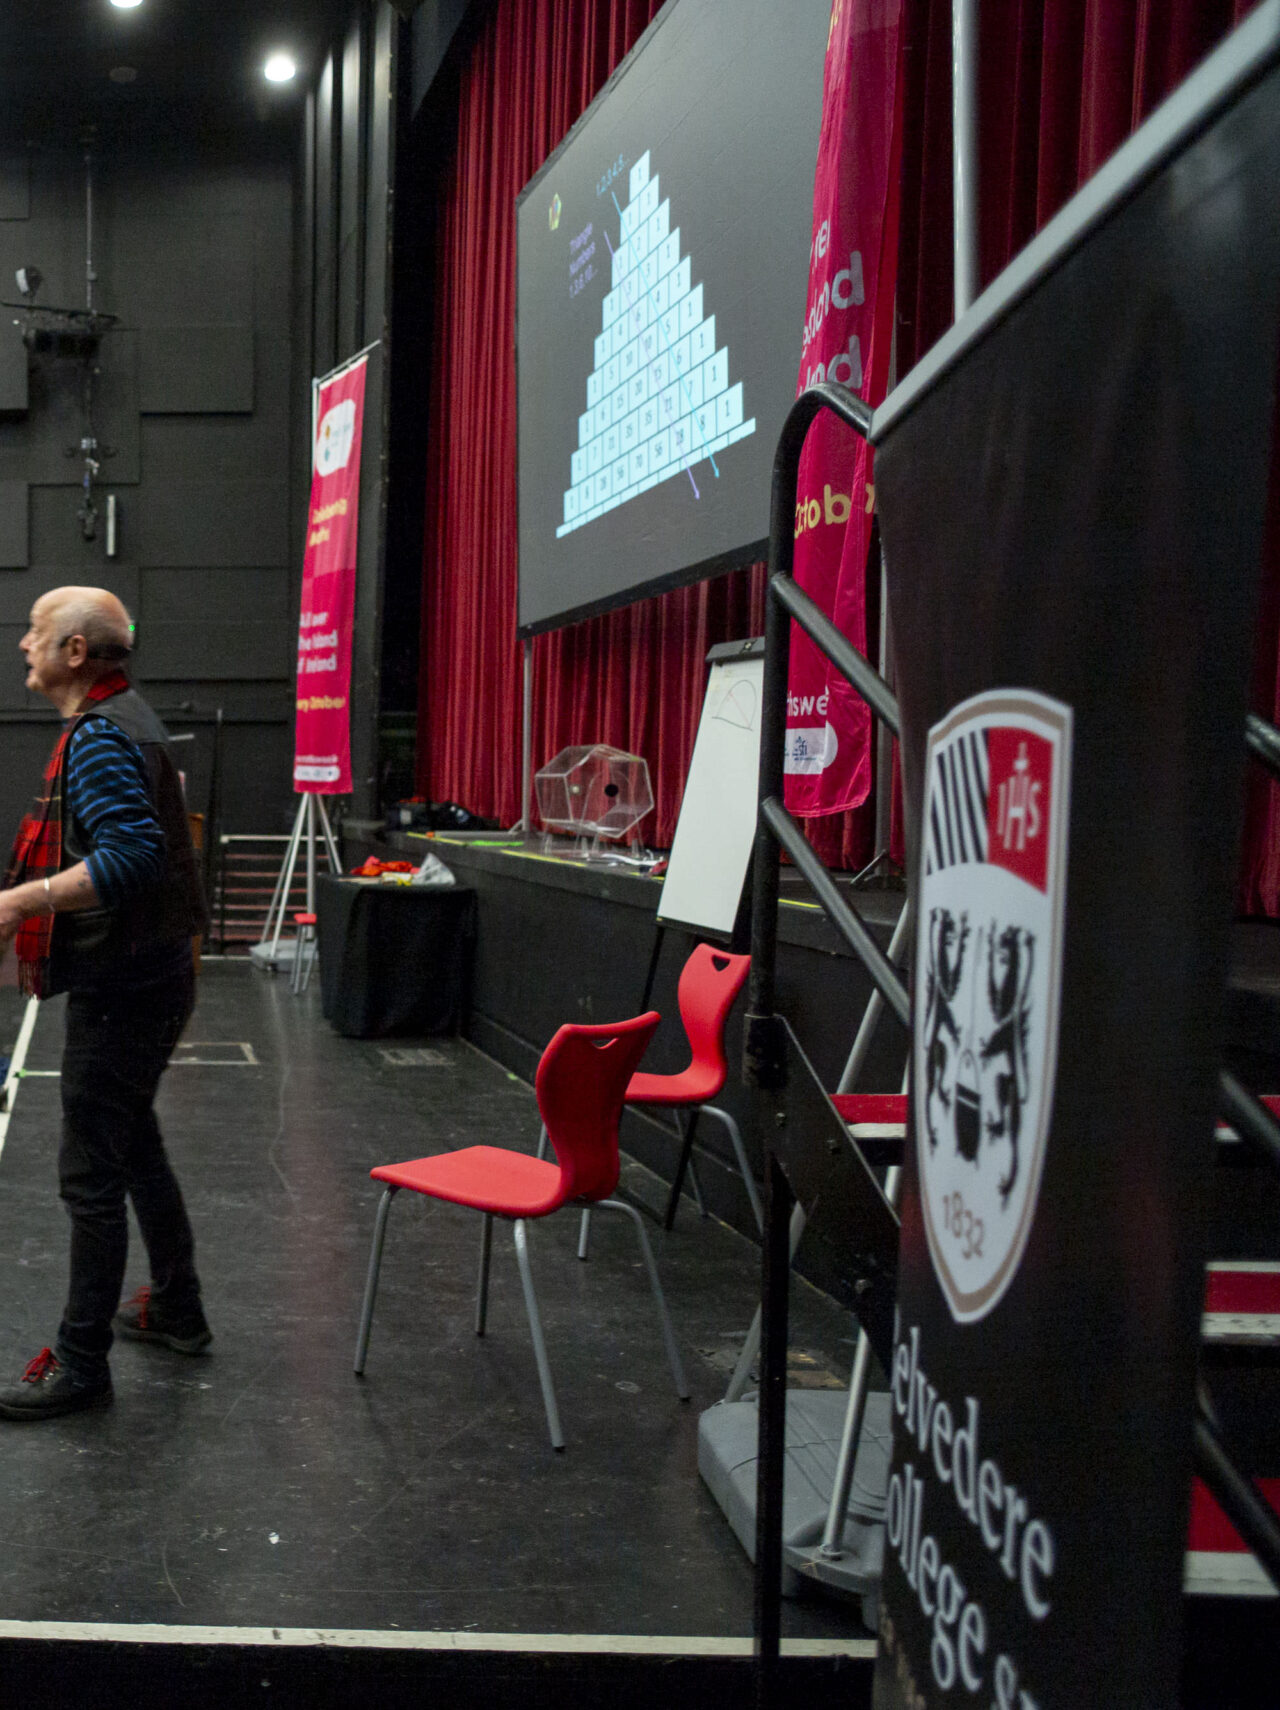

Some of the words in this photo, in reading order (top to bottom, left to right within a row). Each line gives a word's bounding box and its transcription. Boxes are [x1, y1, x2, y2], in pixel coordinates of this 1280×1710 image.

[943, 1192, 985, 1260] 1832
[893, 1304, 1054, 1620] elvedere
[887, 1463, 988, 1690] ollege
